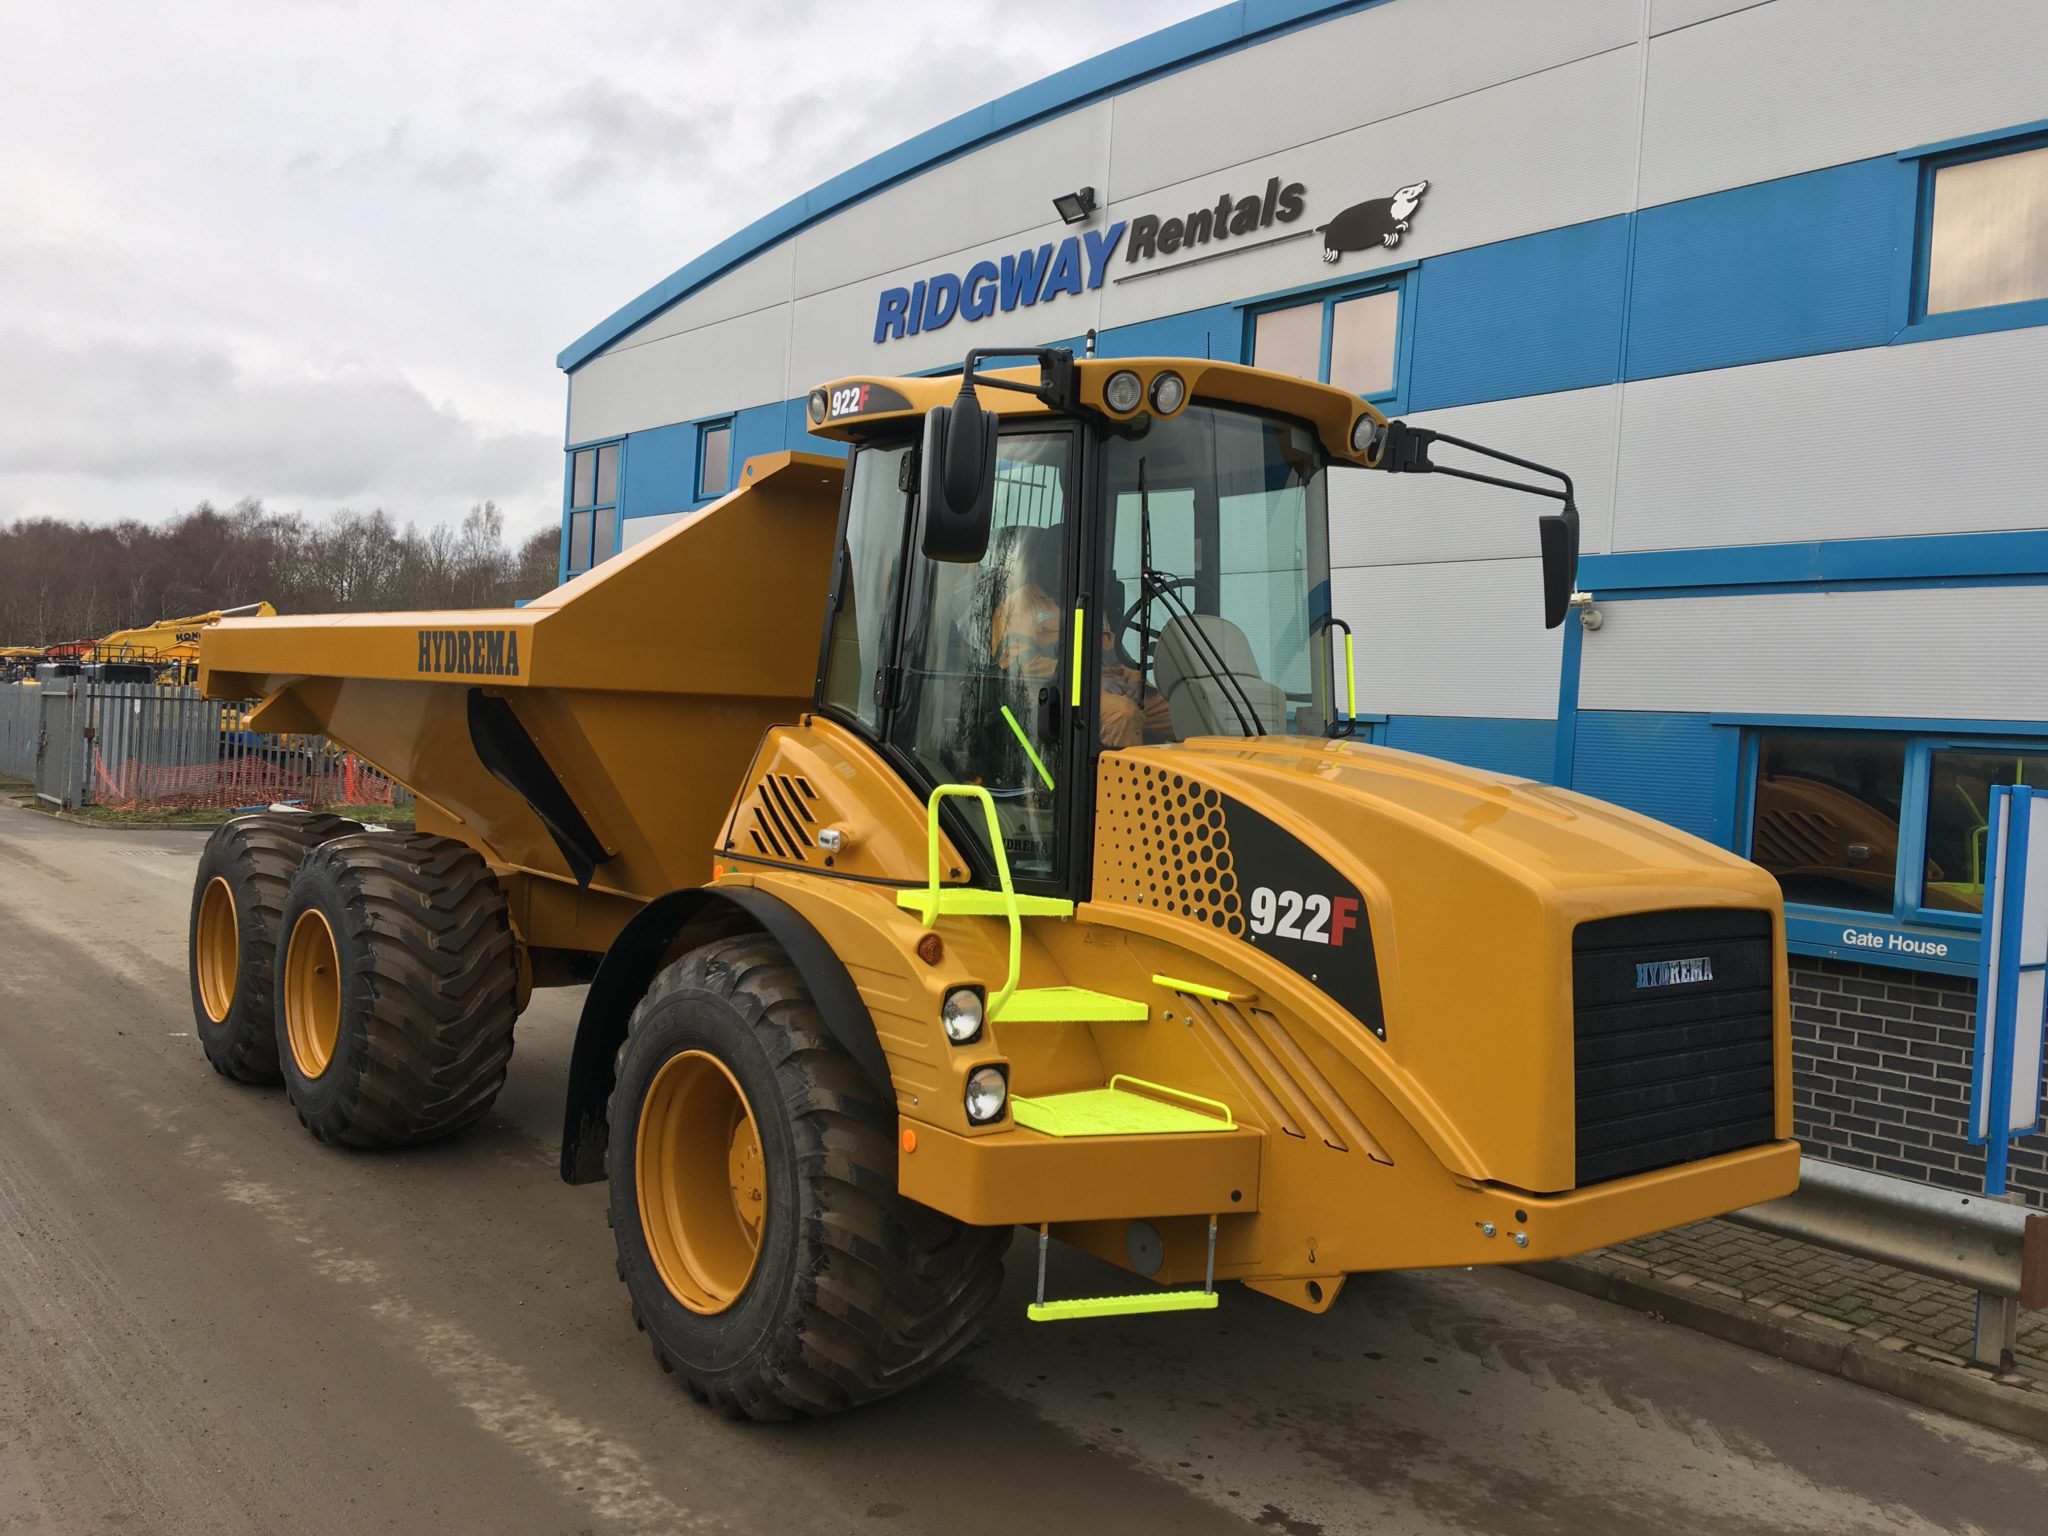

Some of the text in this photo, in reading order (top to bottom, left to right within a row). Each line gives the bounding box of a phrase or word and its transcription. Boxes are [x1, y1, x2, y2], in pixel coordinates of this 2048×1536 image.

[873, 176, 1307, 344] RIDGWAY Rentals
[832, 385, 871, 417] 922F
[418, 630, 520, 676] HYDREMA
[1250, 886, 1360, 947] 922F
[1842, 929, 1948, 957] Gate House
[1636, 956, 1714, 989] HYDREMA
